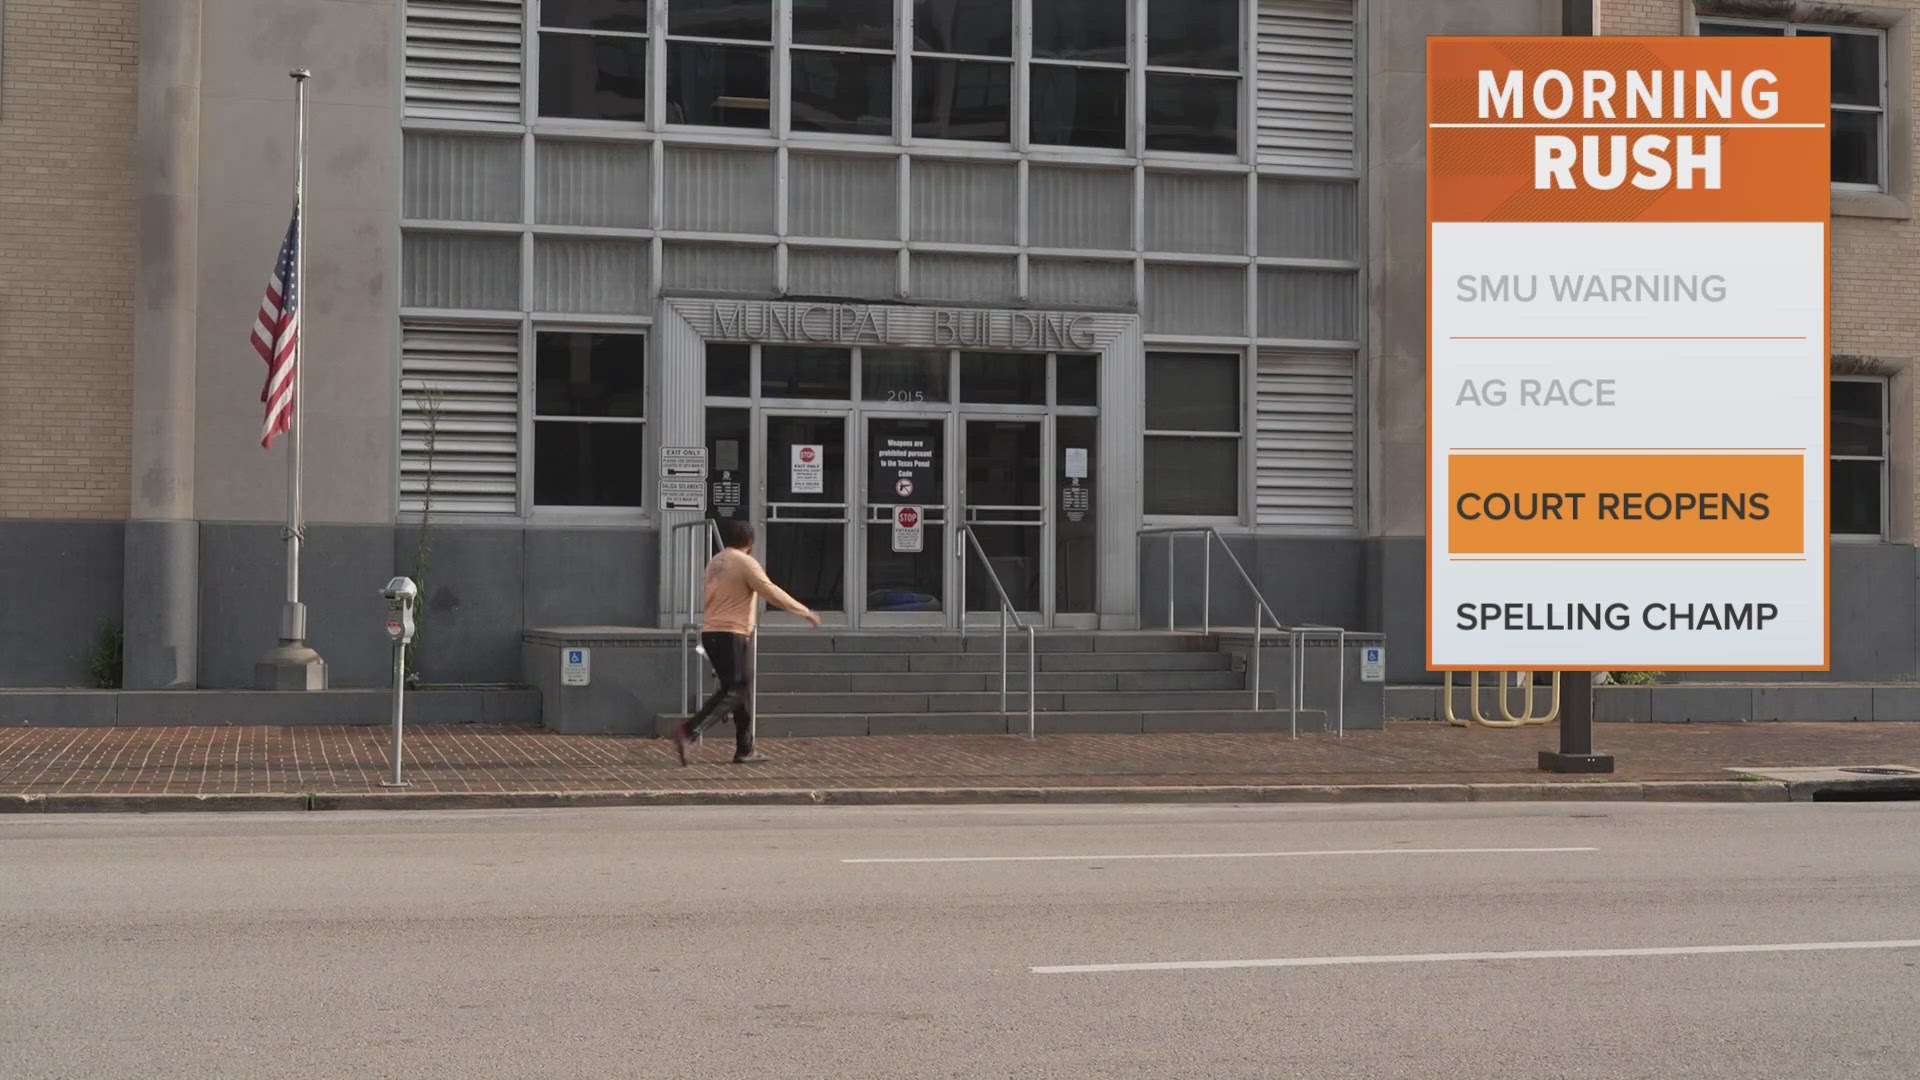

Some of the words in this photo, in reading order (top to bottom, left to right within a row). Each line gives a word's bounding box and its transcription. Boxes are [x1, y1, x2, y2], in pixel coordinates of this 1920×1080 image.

[713, 301, 902, 343] MUNICIPAL
[935, 309, 1096, 349] BUILDING
[887, 390, 924, 402] 2015
[887, 439, 913, 447] Weapons
[800, 451, 815, 459] STOP
[879, 449, 907, 457] prohibited
[899, 513, 917, 522] STOP
